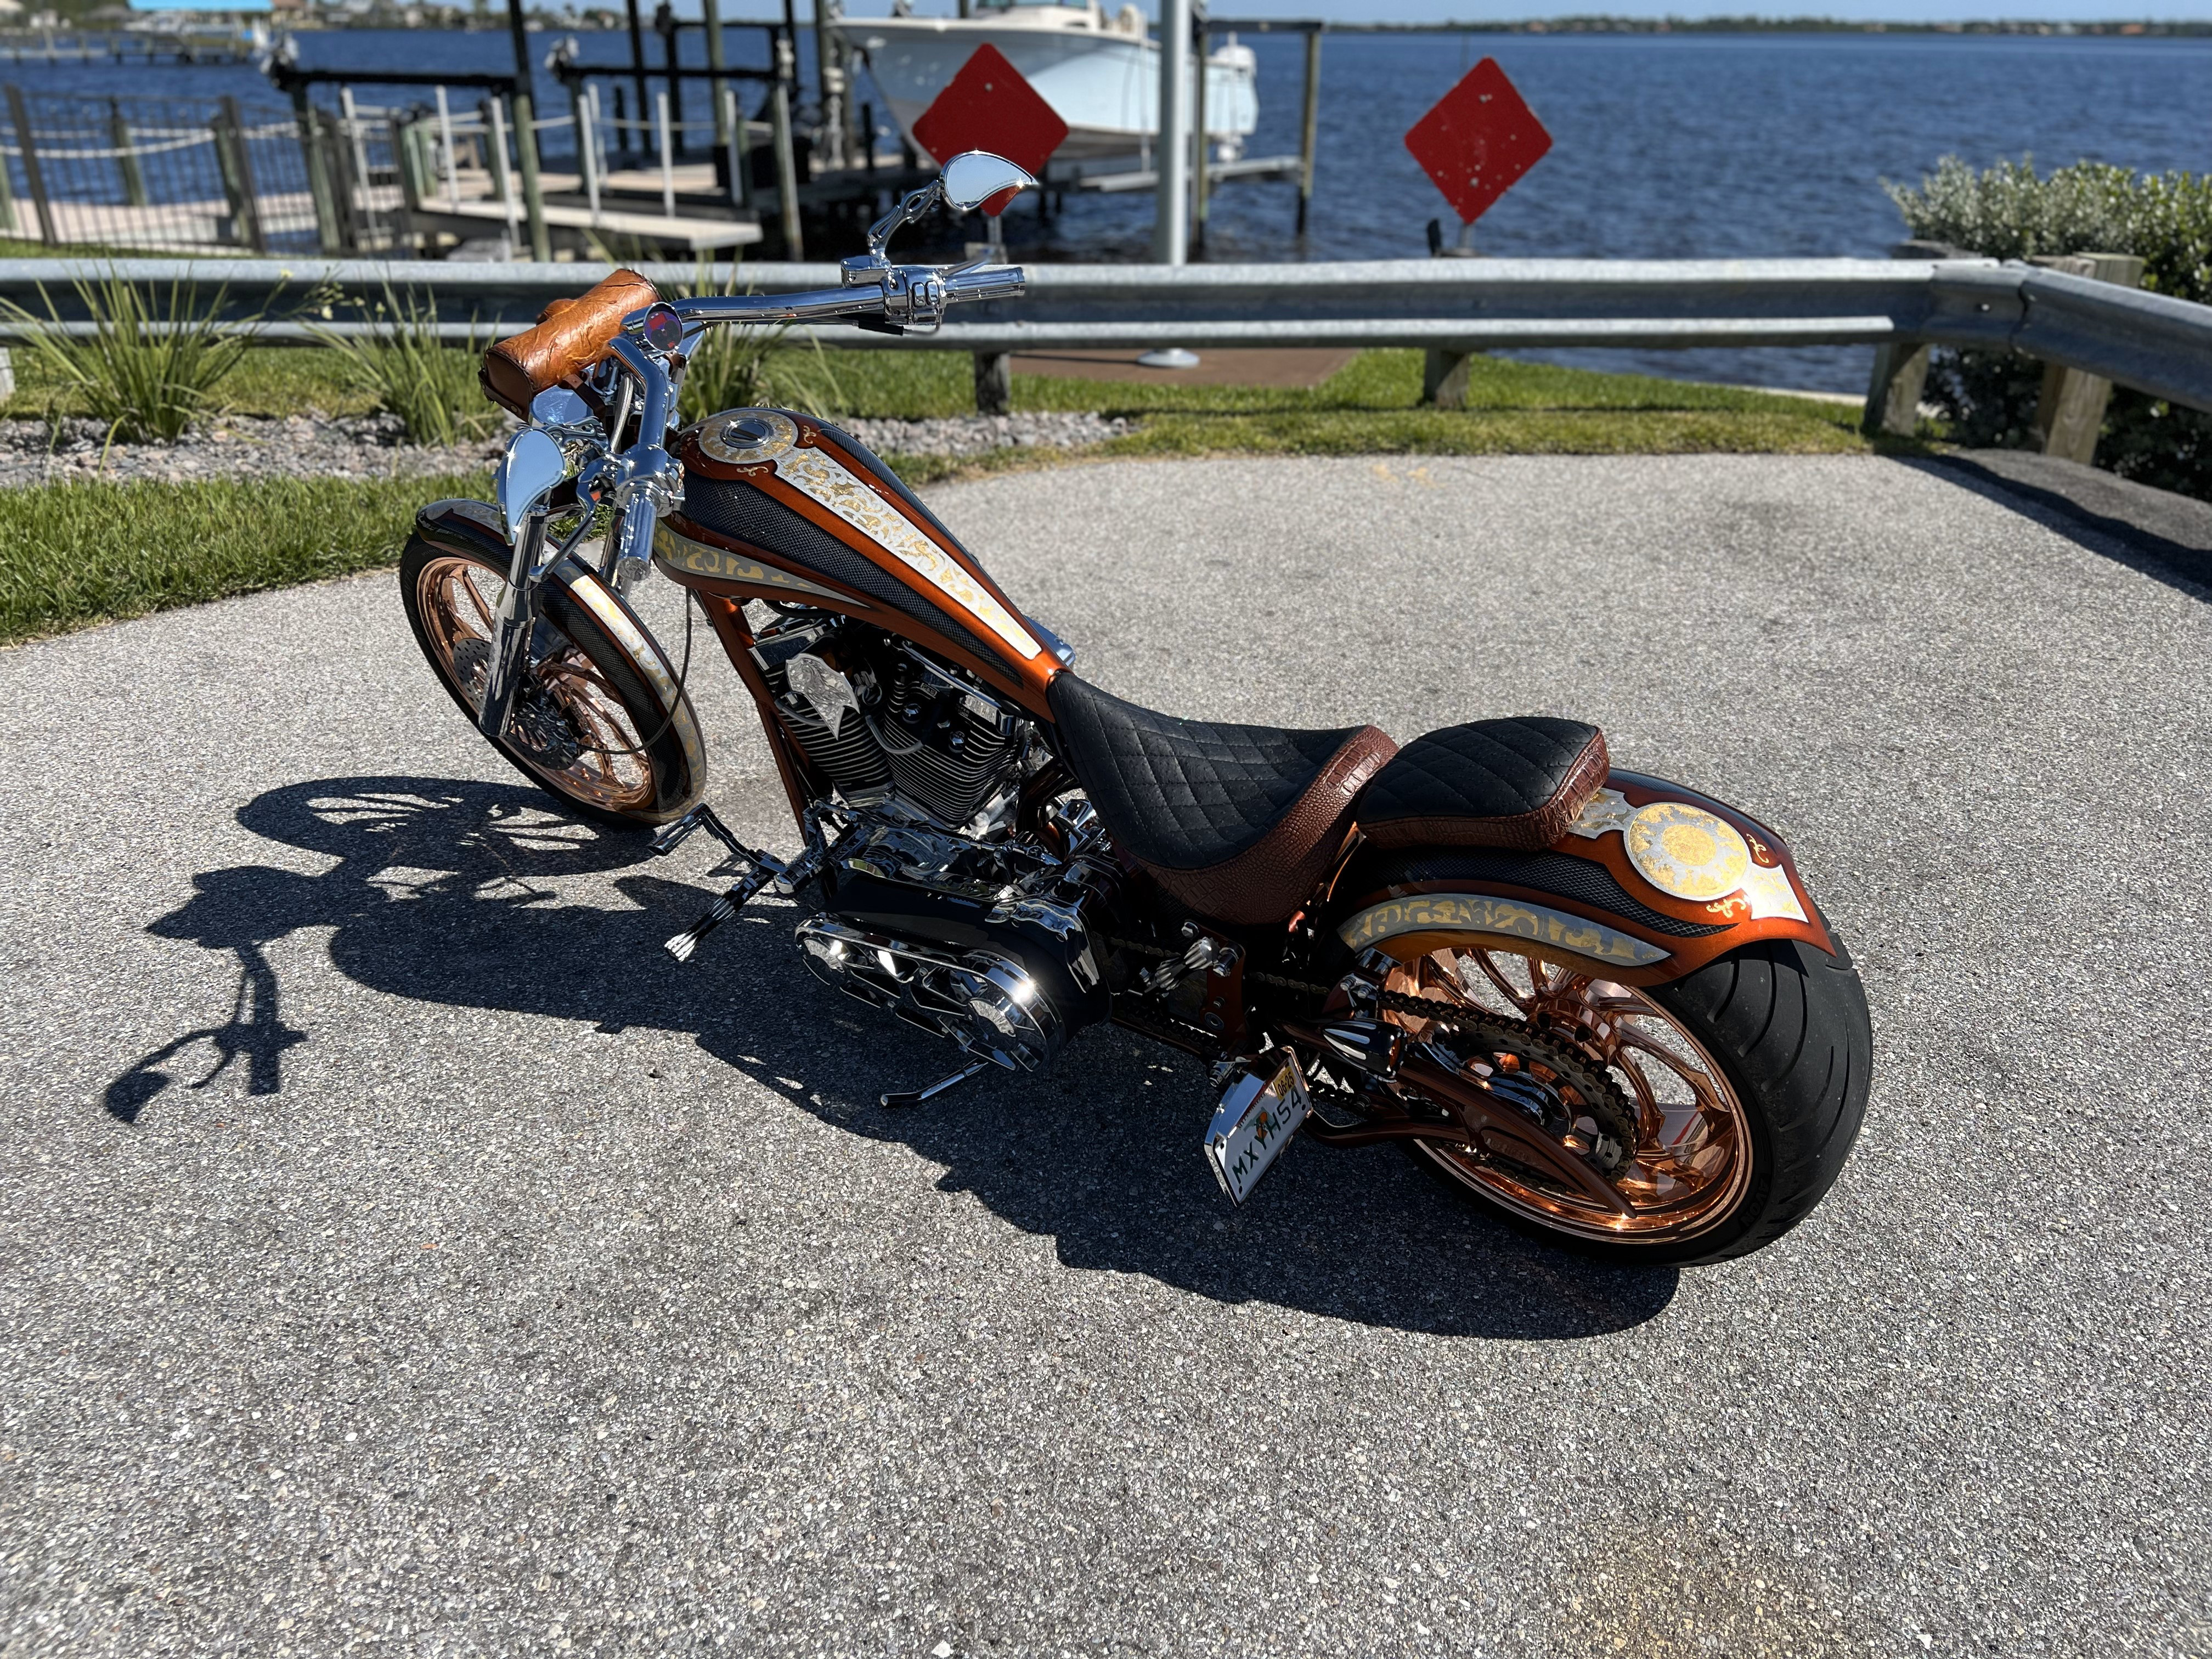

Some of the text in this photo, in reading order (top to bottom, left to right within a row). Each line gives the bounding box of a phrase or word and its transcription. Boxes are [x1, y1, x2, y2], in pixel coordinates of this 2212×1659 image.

[1278, 1071, 1294, 1097] 06-25
[1232, 1086, 1302, 1184] MXYH54
[1740, 1177, 1769, 1227] AVON
